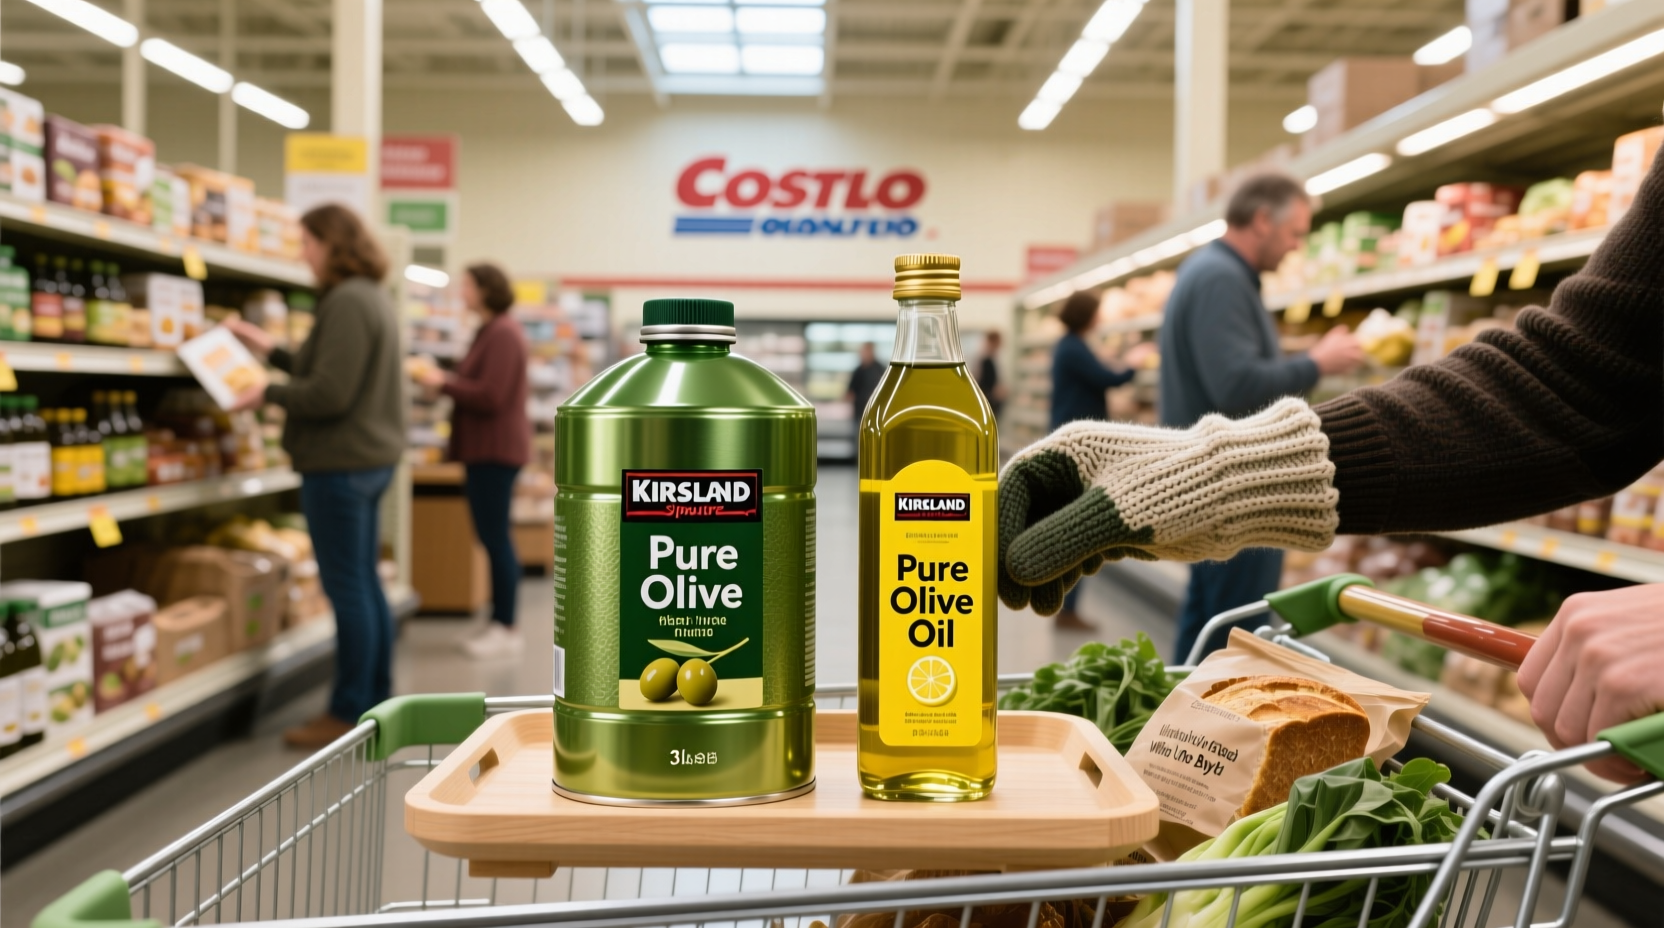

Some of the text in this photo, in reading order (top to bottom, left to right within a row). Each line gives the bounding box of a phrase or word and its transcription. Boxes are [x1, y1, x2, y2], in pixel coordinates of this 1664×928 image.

[674, 155, 928, 210] COSTLO
[632, 479, 751, 503] KIRSLAND
[649, 535, 738, 571] Pure
[897, 554, 969, 582] Pure
[640, 574, 743, 610] Olive
[890, 586, 974, 615] Olive
[908, 618, 954, 648] Oil
